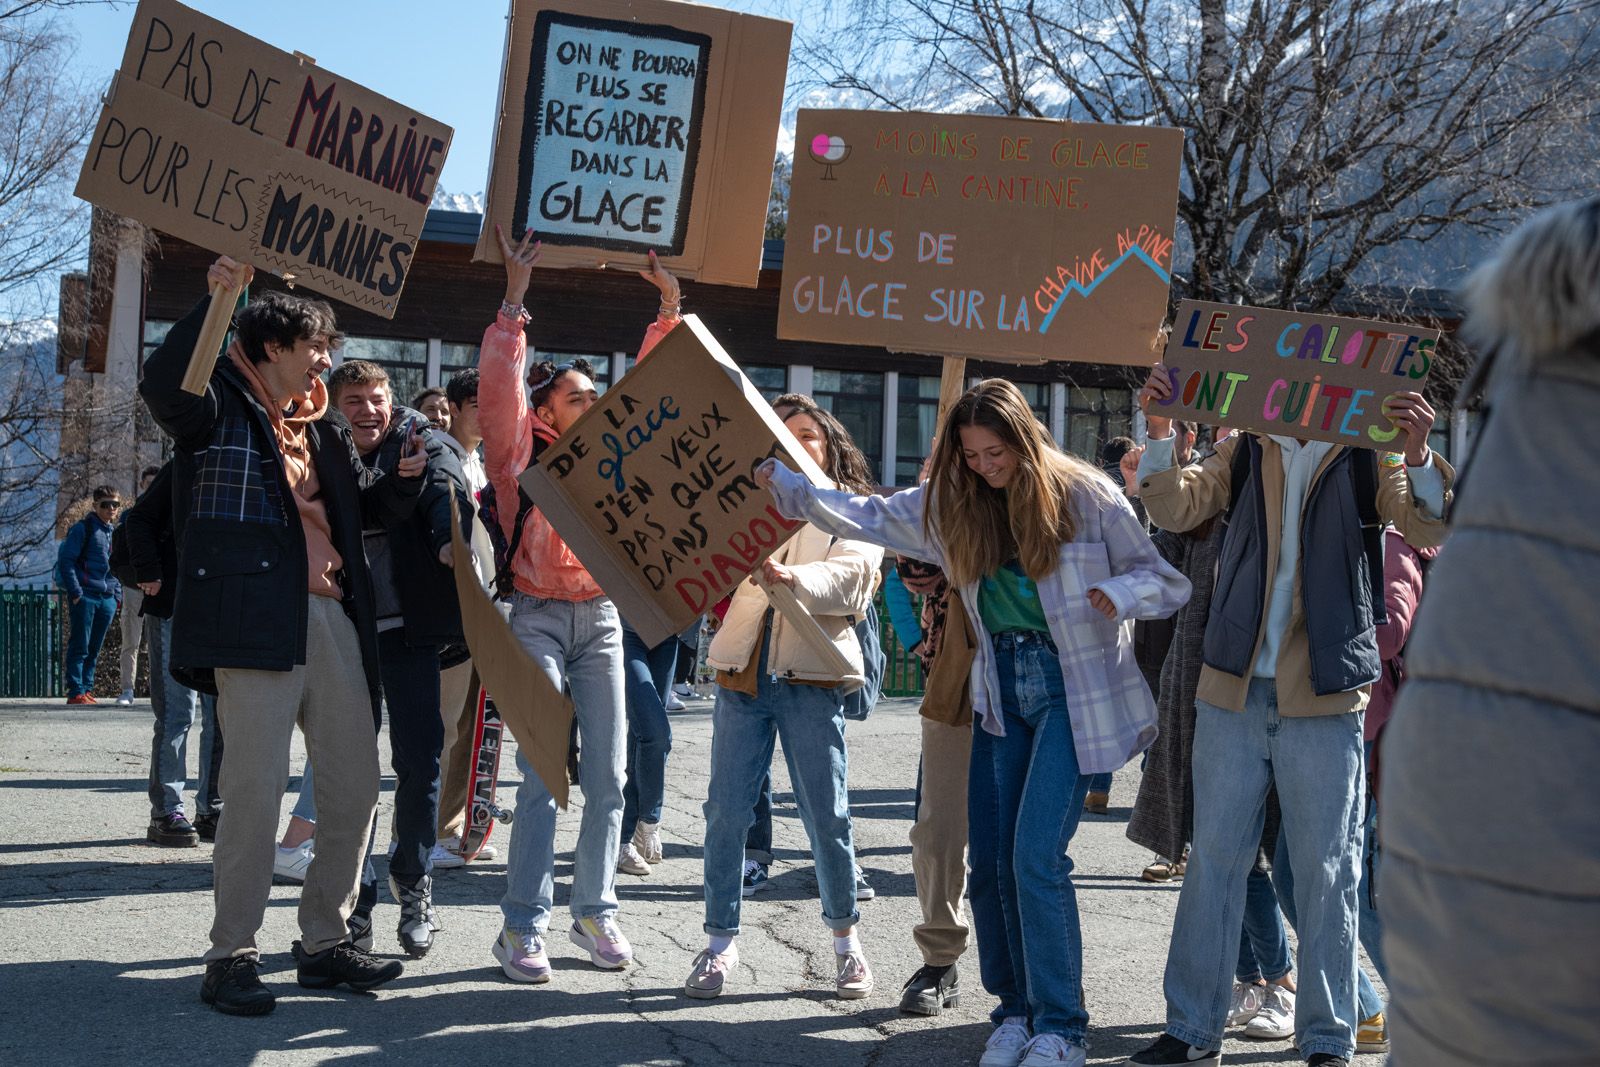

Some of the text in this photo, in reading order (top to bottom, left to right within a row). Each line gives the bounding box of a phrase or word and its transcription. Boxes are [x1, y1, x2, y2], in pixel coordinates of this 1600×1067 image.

[136, 17, 223, 109] PAS
[232, 68, 281, 136] DE
[556, 41, 697, 79] ON NE POURRA
[576, 71, 668, 106] PLUS SE
[545, 99, 686, 152] REGARDER
[1000, 136, 1032, 162] DE
[1051, 140, 1150, 170] GLACE
[93, 117, 189, 208] POUR
[194, 159, 256, 232] LES
[571, 149, 669, 183] DANS LA
[901, 170, 939, 198] LA
[540, 180, 666, 233] GLACE
[813, 224, 957, 265] PLUS DE
[793, 275, 1031, 332] GLACE SUR LA
[1182, 309, 1436, 380] LES CALOTTES
[1156, 367, 1249, 418] SONT
[547, 393, 642, 480] DE LA
[597, 395, 681, 493] glace
[660, 401, 732, 470] VEUX
[617, 443, 736, 567] PAS QUE
[641, 511, 708, 592] DANS
